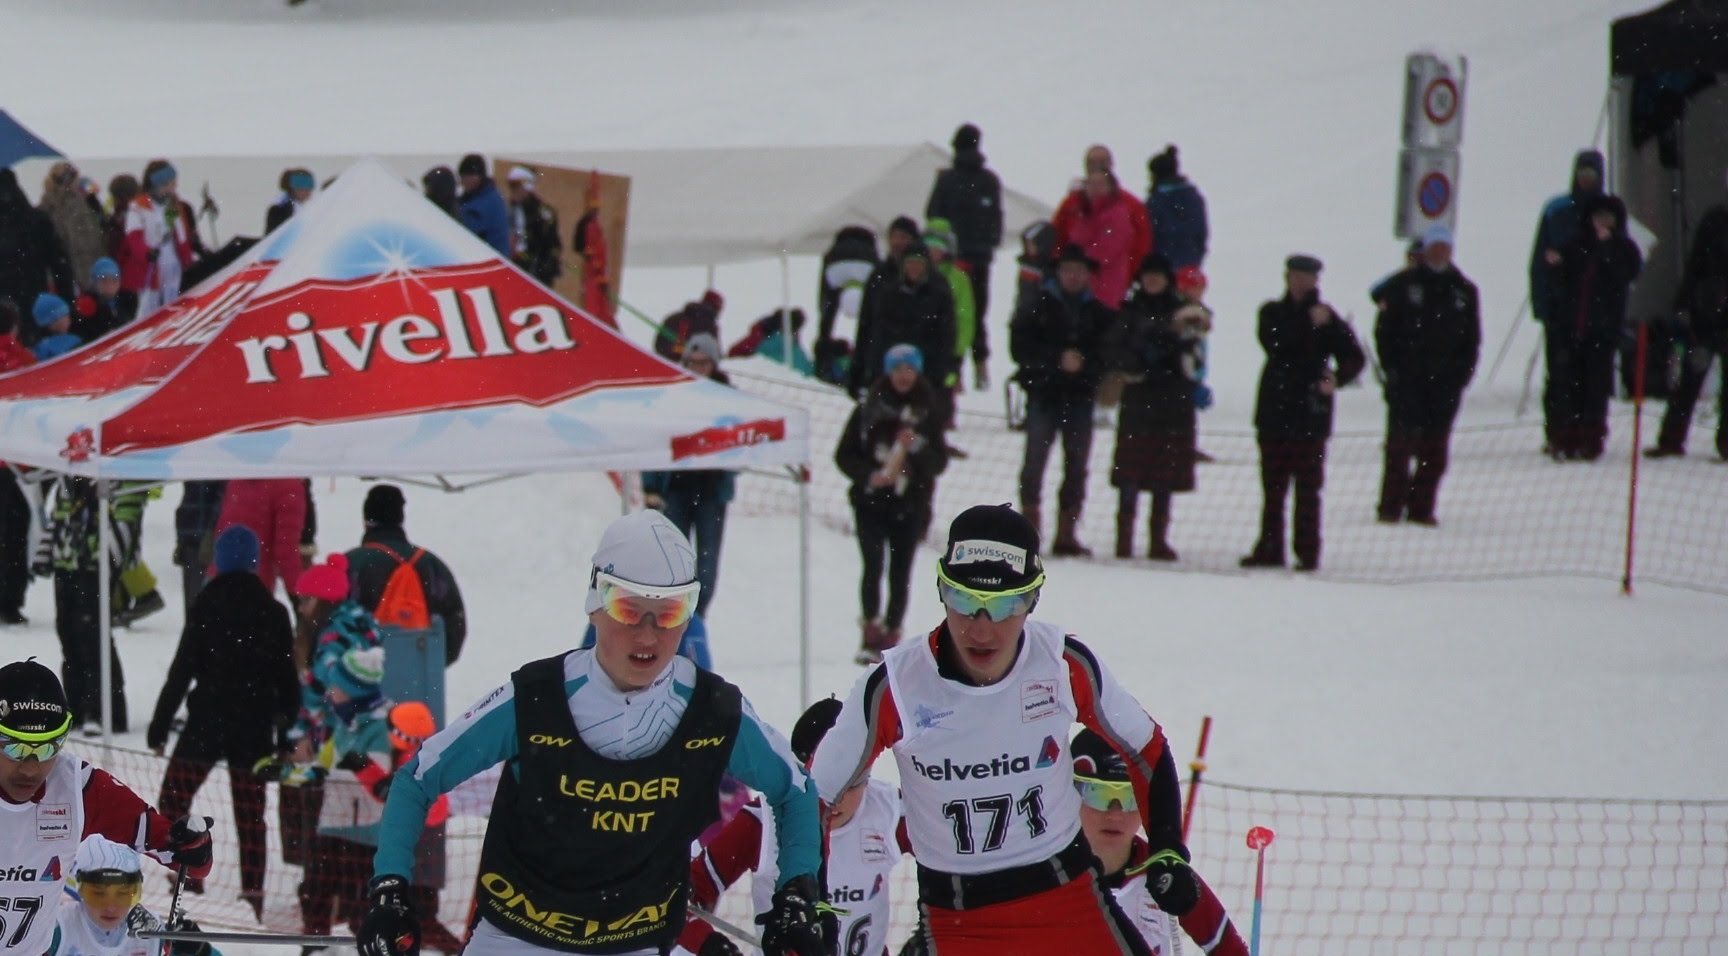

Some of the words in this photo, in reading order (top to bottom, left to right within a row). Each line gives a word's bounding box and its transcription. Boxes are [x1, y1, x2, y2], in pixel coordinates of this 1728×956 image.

[235, 285, 577, 385] rivella
[967, 546, 1024, 564] swisscom
[12, 699, 63, 713] swisscom
[911, 753, 1031, 781] helvetia
[559, 774, 680, 802] LEADER
[591, 811, 655, 833] KNT
[942, 784, 1048, 855] 171
[488, 898, 504, 914] THE
[503, 910, 556, 939] AUTHENTIC
[555, 934, 595, 945] NORDIC
[596, 930, 635, 944] SPORTS
[636, 920, 667, 934] BRAND
